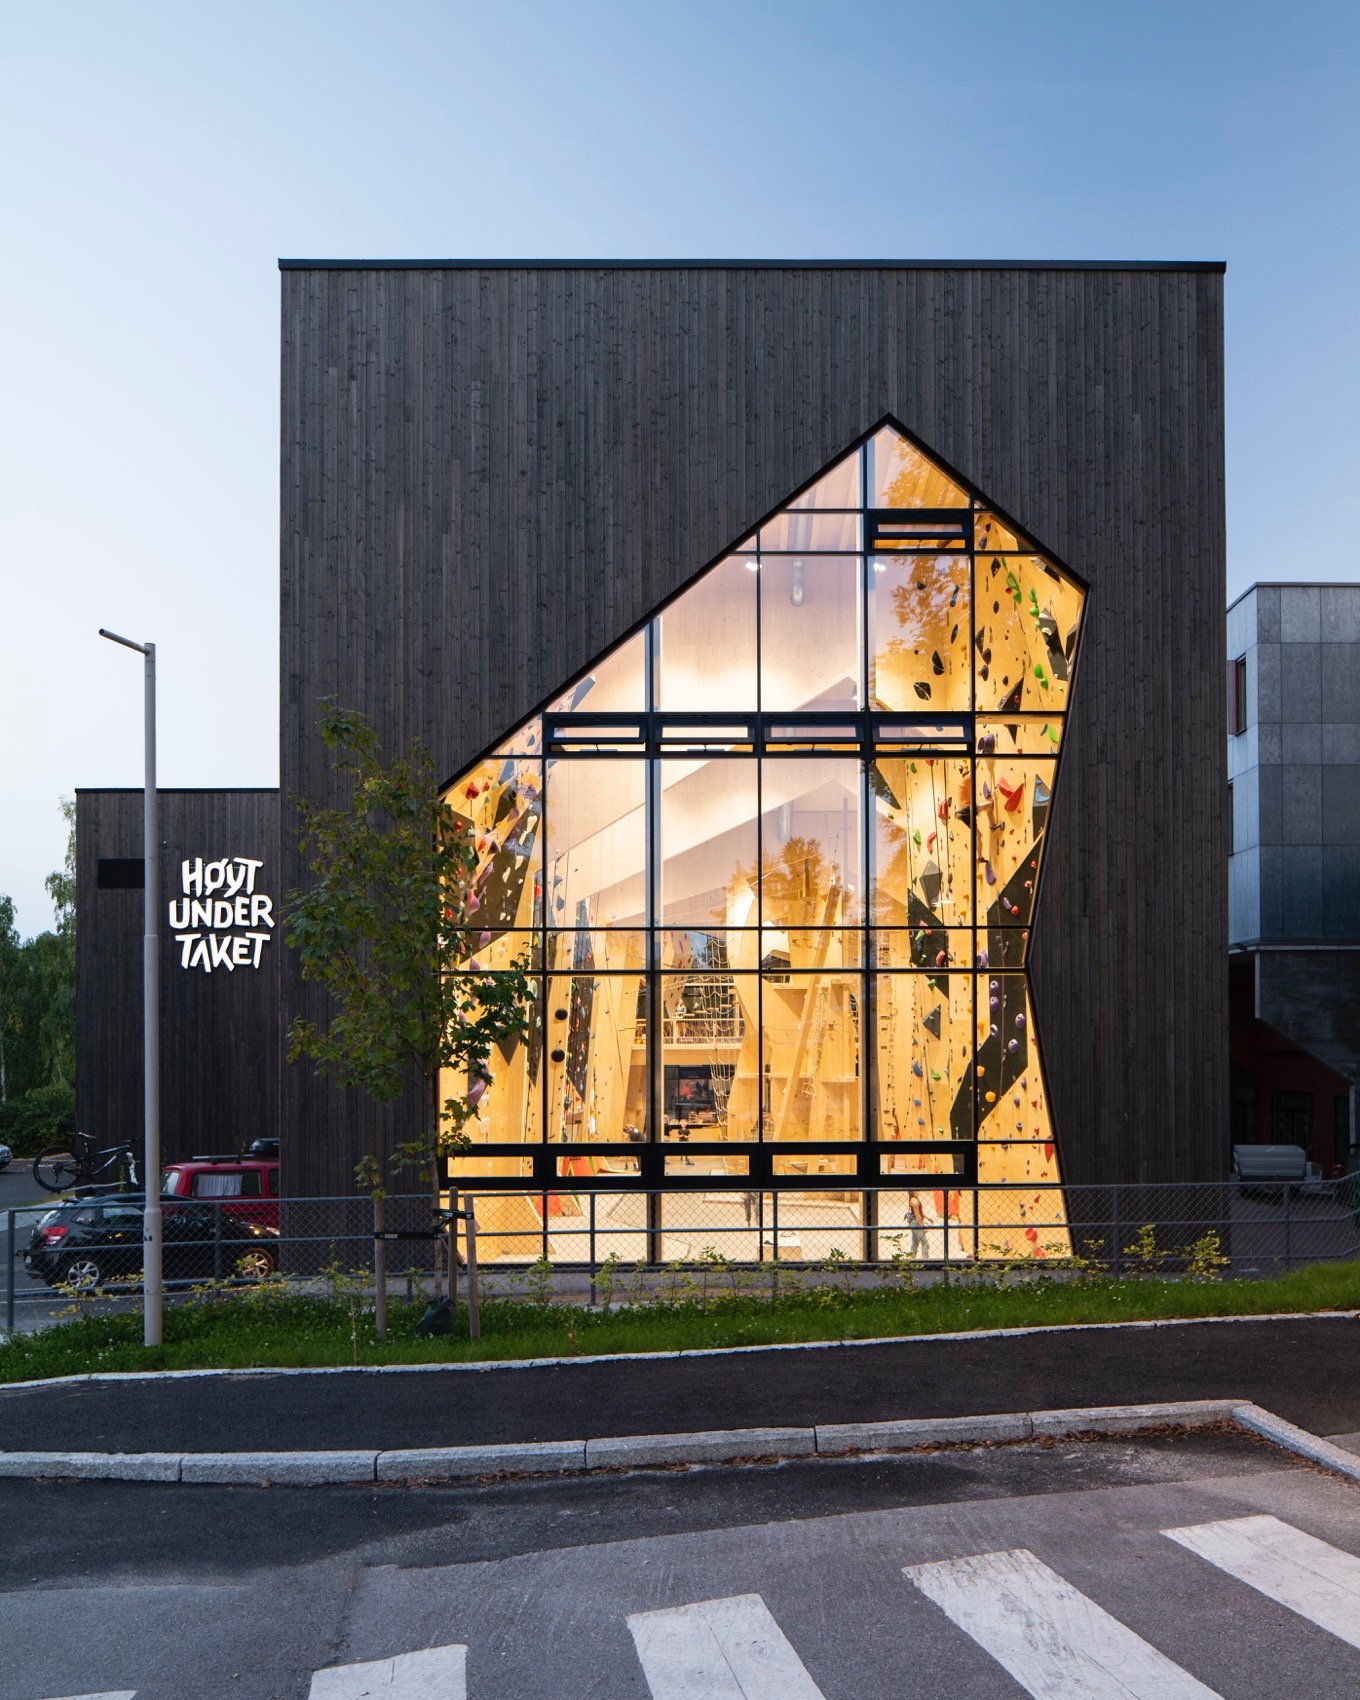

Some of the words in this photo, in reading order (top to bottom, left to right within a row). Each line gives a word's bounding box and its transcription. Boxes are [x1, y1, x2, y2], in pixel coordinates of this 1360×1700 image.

[181, 857, 264, 898] HØYT
[169, 894, 276, 930] UNDER
[175, 932, 271, 973] TAKET
